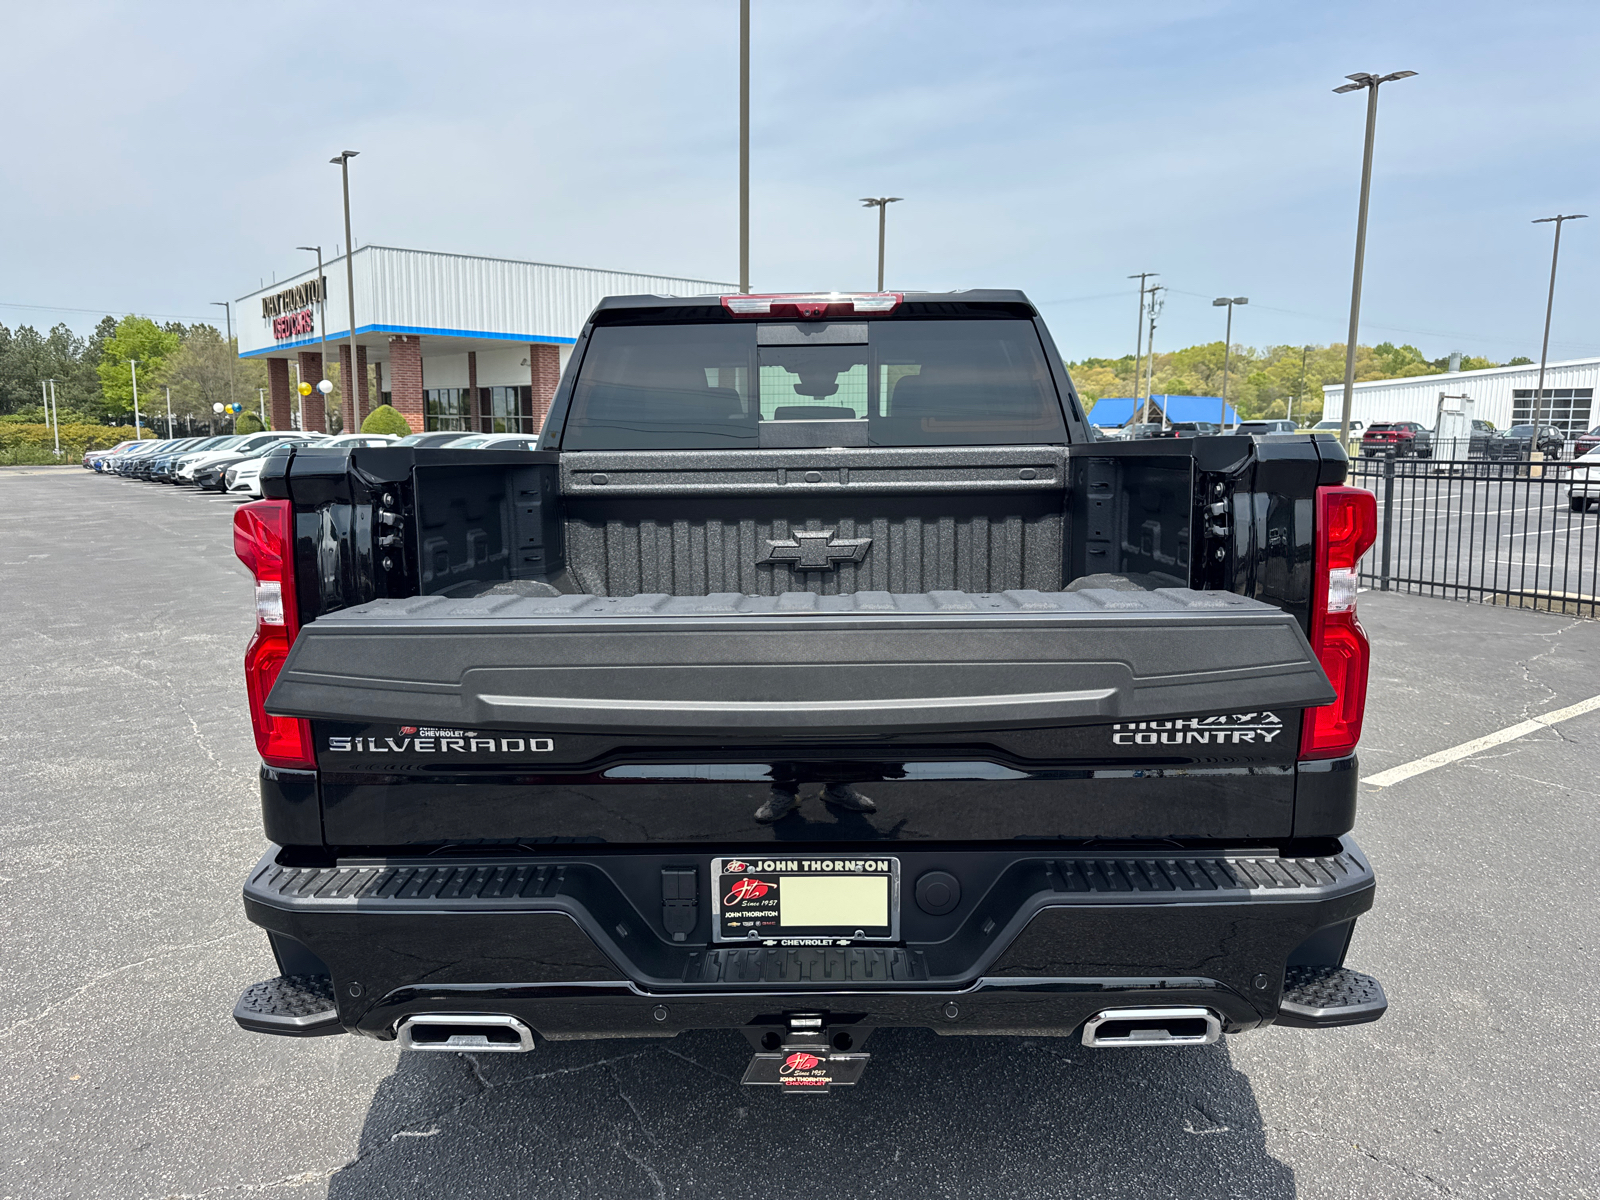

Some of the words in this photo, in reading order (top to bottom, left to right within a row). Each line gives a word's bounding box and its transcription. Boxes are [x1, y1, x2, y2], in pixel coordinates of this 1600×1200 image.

[261, 294, 281, 318] JOHN
[273, 316, 291, 340] USED
[290, 309, 312, 335] CARS
[1112, 729, 1281, 744] COUNTRY
[329, 737, 555, 752] SILVERADO
[756, 861, 798, 871] JOHN
[802, 860, 888, 871] THORNTON
